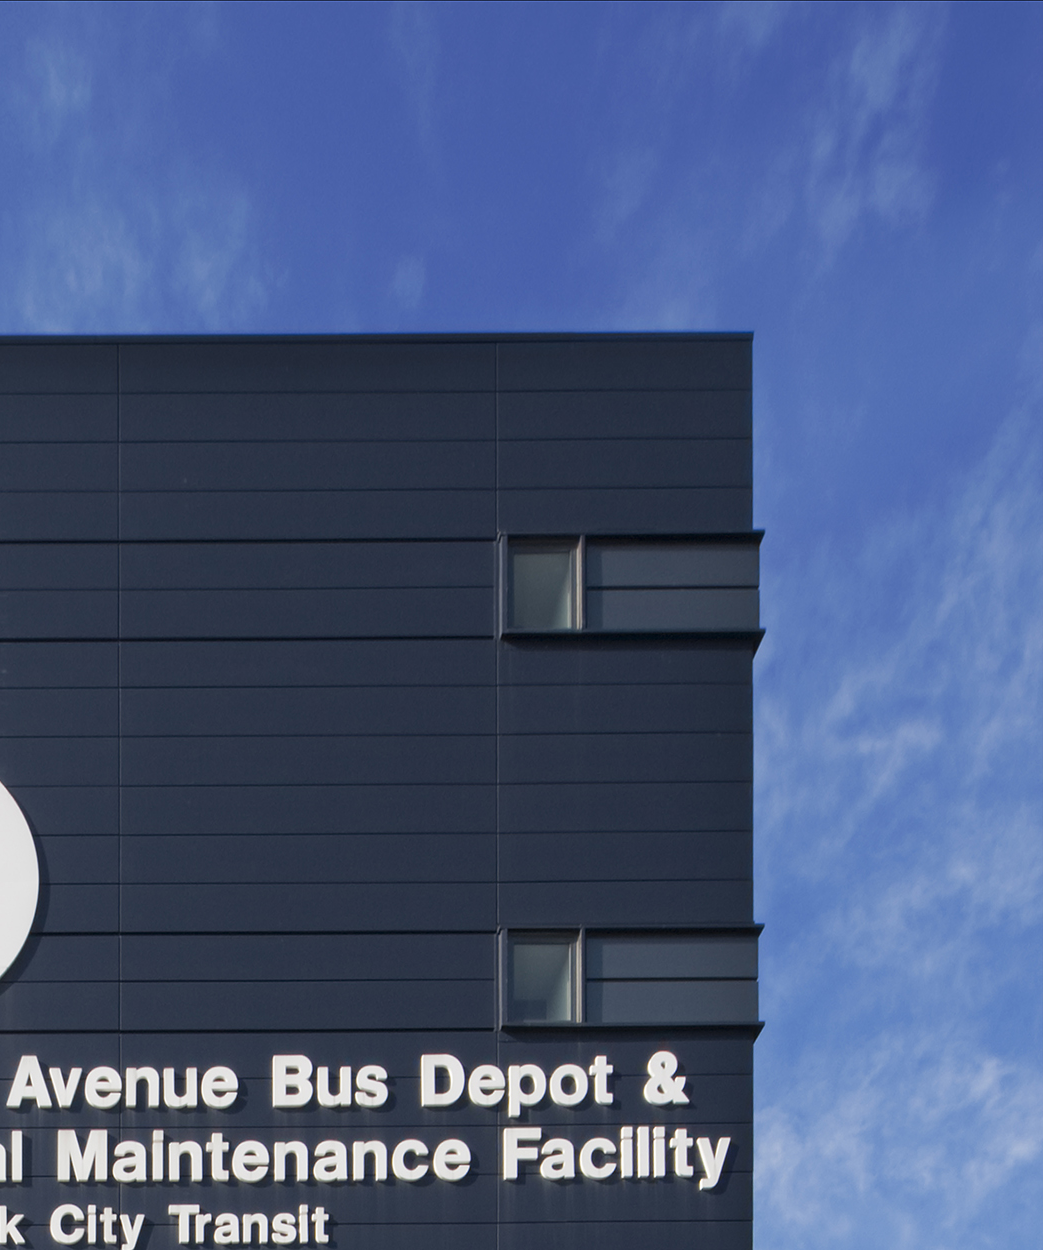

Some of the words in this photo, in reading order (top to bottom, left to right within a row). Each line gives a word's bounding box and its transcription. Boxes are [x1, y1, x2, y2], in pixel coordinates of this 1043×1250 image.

[5, 1054, 239, 1109] Avenue
[271, 1054, 389, 1108] Bus
[420, 1053, 614, 1118] Depot
[643, 1051, 690, 1105] &
[56, 1129, 472, 1183] Maintenance
[502, 1126, 731, 1191] Facility
[167, 1203, 330, 1246] Transit
